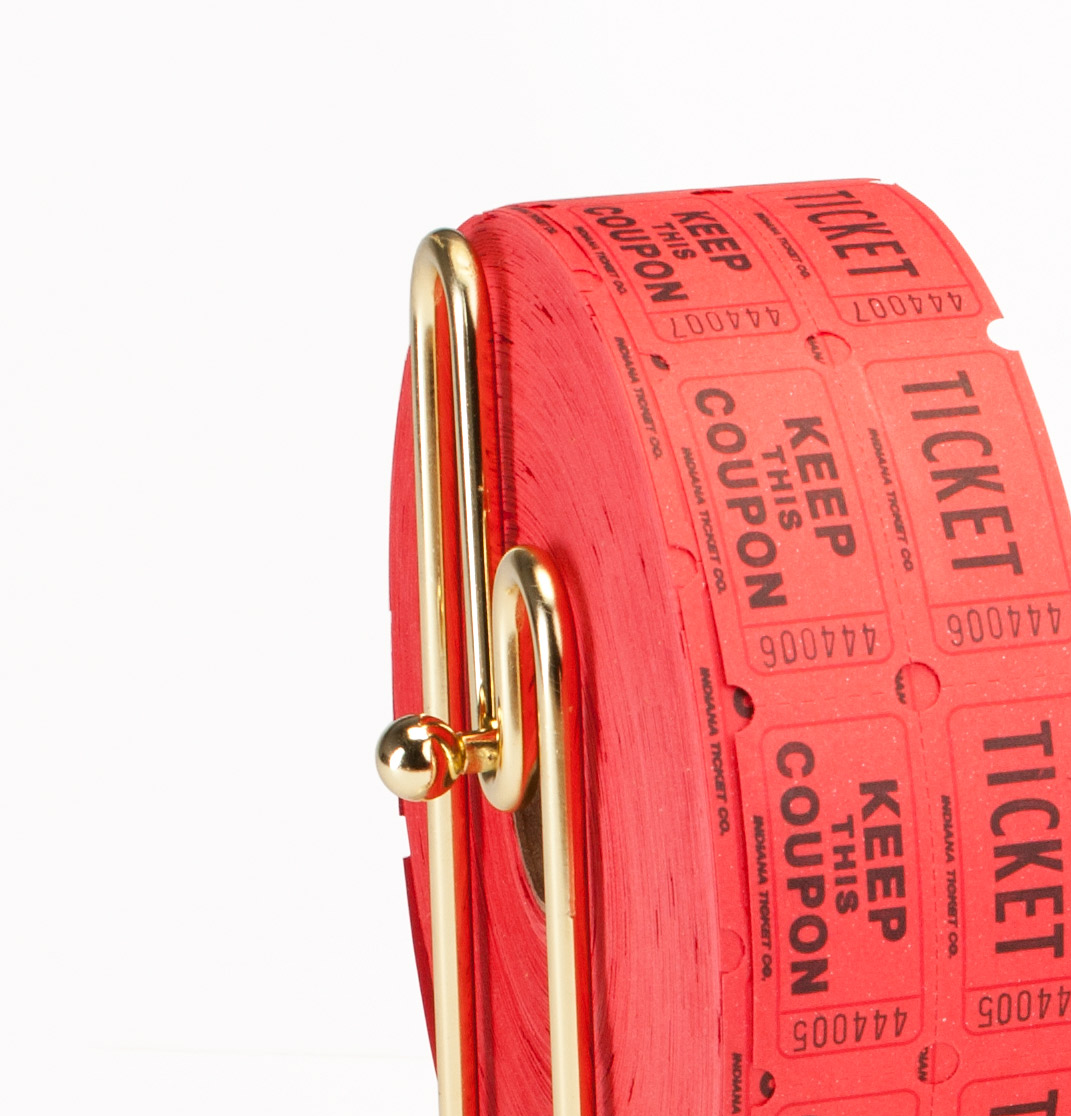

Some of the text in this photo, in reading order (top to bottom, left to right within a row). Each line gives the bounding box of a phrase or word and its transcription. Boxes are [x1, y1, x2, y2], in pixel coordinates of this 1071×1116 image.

[583, 206, 689, 303] COUPON
[652, 221, 697, 260] THIS
[671, 210, 752, 271] KEEP
[784, 190, 920, 277] TICKET
[670, 306, 780, 338] 444007
[853, 291, 962, 322] 444007
[614, 336, 639, 383] INDIANA
[633, 388, 657, 438] TICKET
[681, 447, 706, 505] INDIANA
[701, 510, 721, 565] TICKET
[695, 388, 788, 610] COUPON
[762, 445, 802, 532] THIS
[783, 416, 856, 558] KEEP
[868, 427, 892, 486] INDIANA
[886, 490, 909, 546] TICKET
[902, 370, 1024, 576] TICKET
[760, 622, 877, 669] 444006
[947, 601, 1061, 647] 444006
[700, 667, 718, 736] INDIANA
[710, 741, 728, 805] TICKET
[753, 815, 770, 886] INDIANA
[776, 741, 829, 997] COUPON
[831, 814, 859, 915] THIS
[858, 779, 907, 943] KEEP
[941, 794, 955, 862] INDIANA
[982, 719, 1065, 959] TICKET
[758, 888, 773, 958] TICKET
[945, 869, 959, 929] TICKET
[792, 1005, 908, 1053] 444005
[730, 1052, 742, 1115] INDIANA
